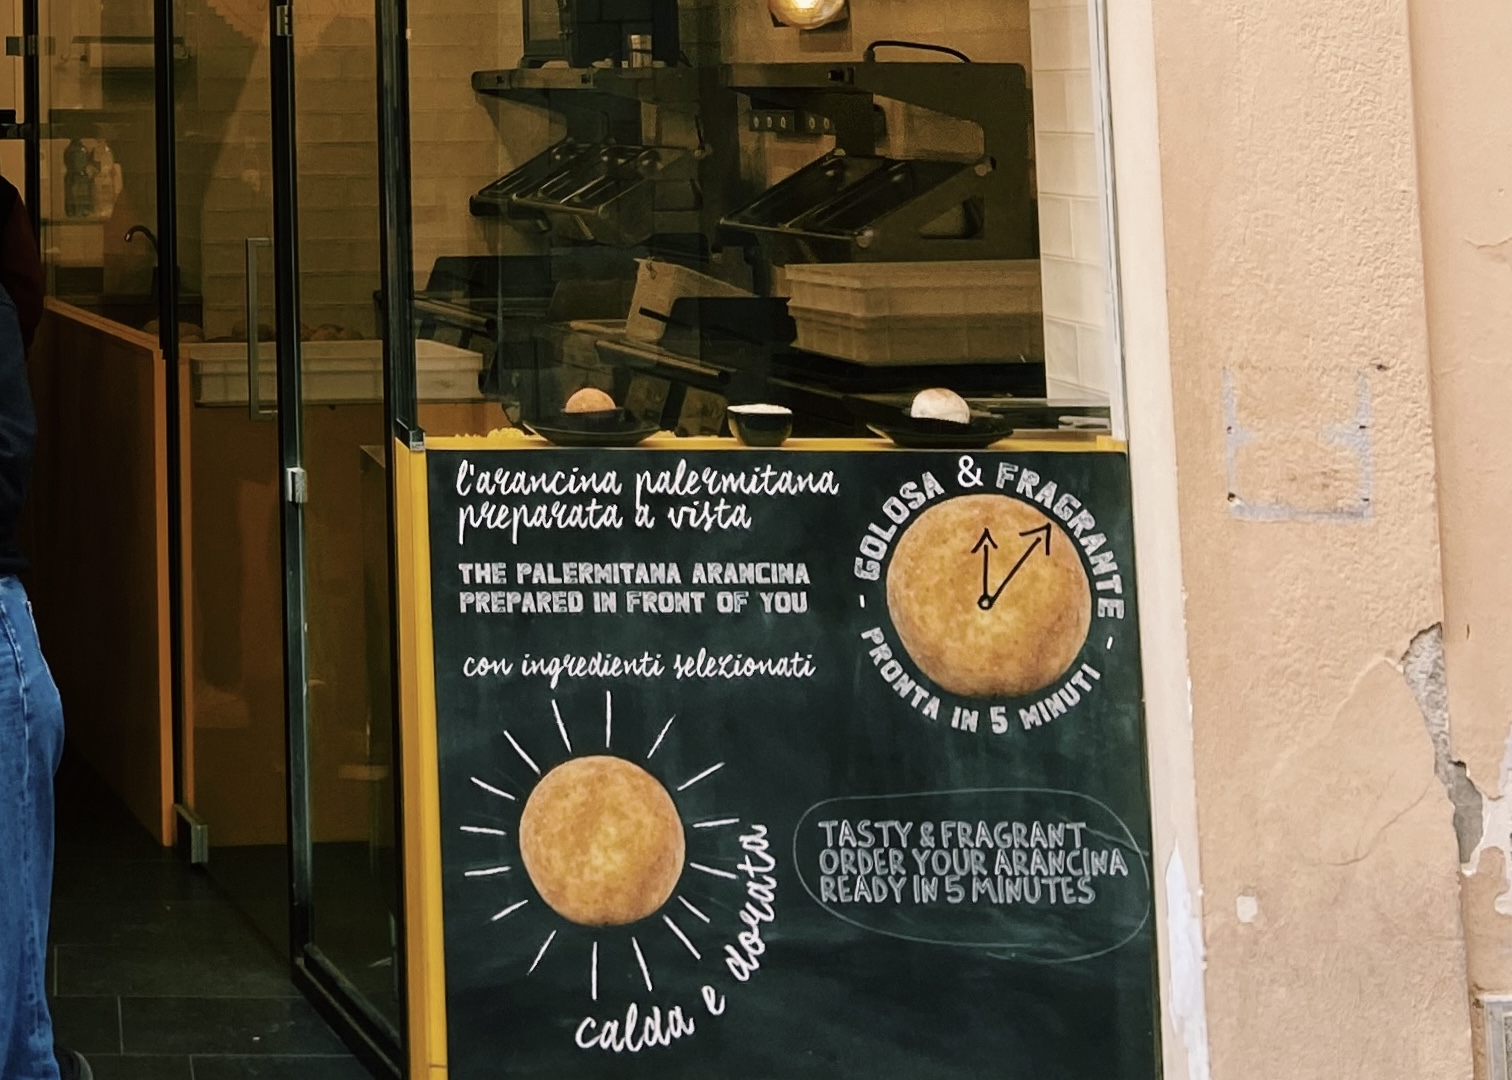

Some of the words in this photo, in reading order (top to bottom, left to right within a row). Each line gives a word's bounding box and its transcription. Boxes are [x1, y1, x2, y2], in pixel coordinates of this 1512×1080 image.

[456, 459, 622, 497] l'arancina
[635, 458, 840, 509] palermitana
[458, 497, 622, 545] preparata
[635, 504, 655, 529] a
[668, 497, 752, 533] vista
[854, 471, 946, 582] GOLOSA
[957, 455, 984, 488] &
[995, 462, 1124, 620] FRAGRANTE
[458, 562, 507, 585] THE
[517, 562, 682, 585] PALERMITANA
[692, 562, 810, 585] ARANCINA
[459, 590, 584, 614] PREPARED
[593, 591, 617, 614] IN
[626, 591, 702, 614] FRONT
[717, 591, 749, 614] OF
[760, 591, 808, 614] YOU
[463, 654, 513, 677] con
[522, 650, 665, 690] ingredienti
[674, 647, 816, 680] selezionati
[861, 627, 940, 720] PRONTA
[951, 706, 979, 733] IN
[990, 706, 1008, 734] 5
[1018, 663, 1101, 730] MINUTI
[818, 820, 913, 848] TASTY
[920, 822, 935, 848] &
[941, 820, 1086, 848] FRAGRANT
[819, 848, 906, 876] ORDER
[912, 848, 988, 876] YOUR
[994, 848, 1128, 877] ARANCINA
[820, 875, 906, 904] READY
[913, 876, 938, 903] IN
[946, 875, 964, 904] 5
[972, 875, 1096, 904] MINUTES
[576, 1002, 695, 1053] calda
[701, 985, 726, 1016] e
[724, 824, 778, 982] dorata
